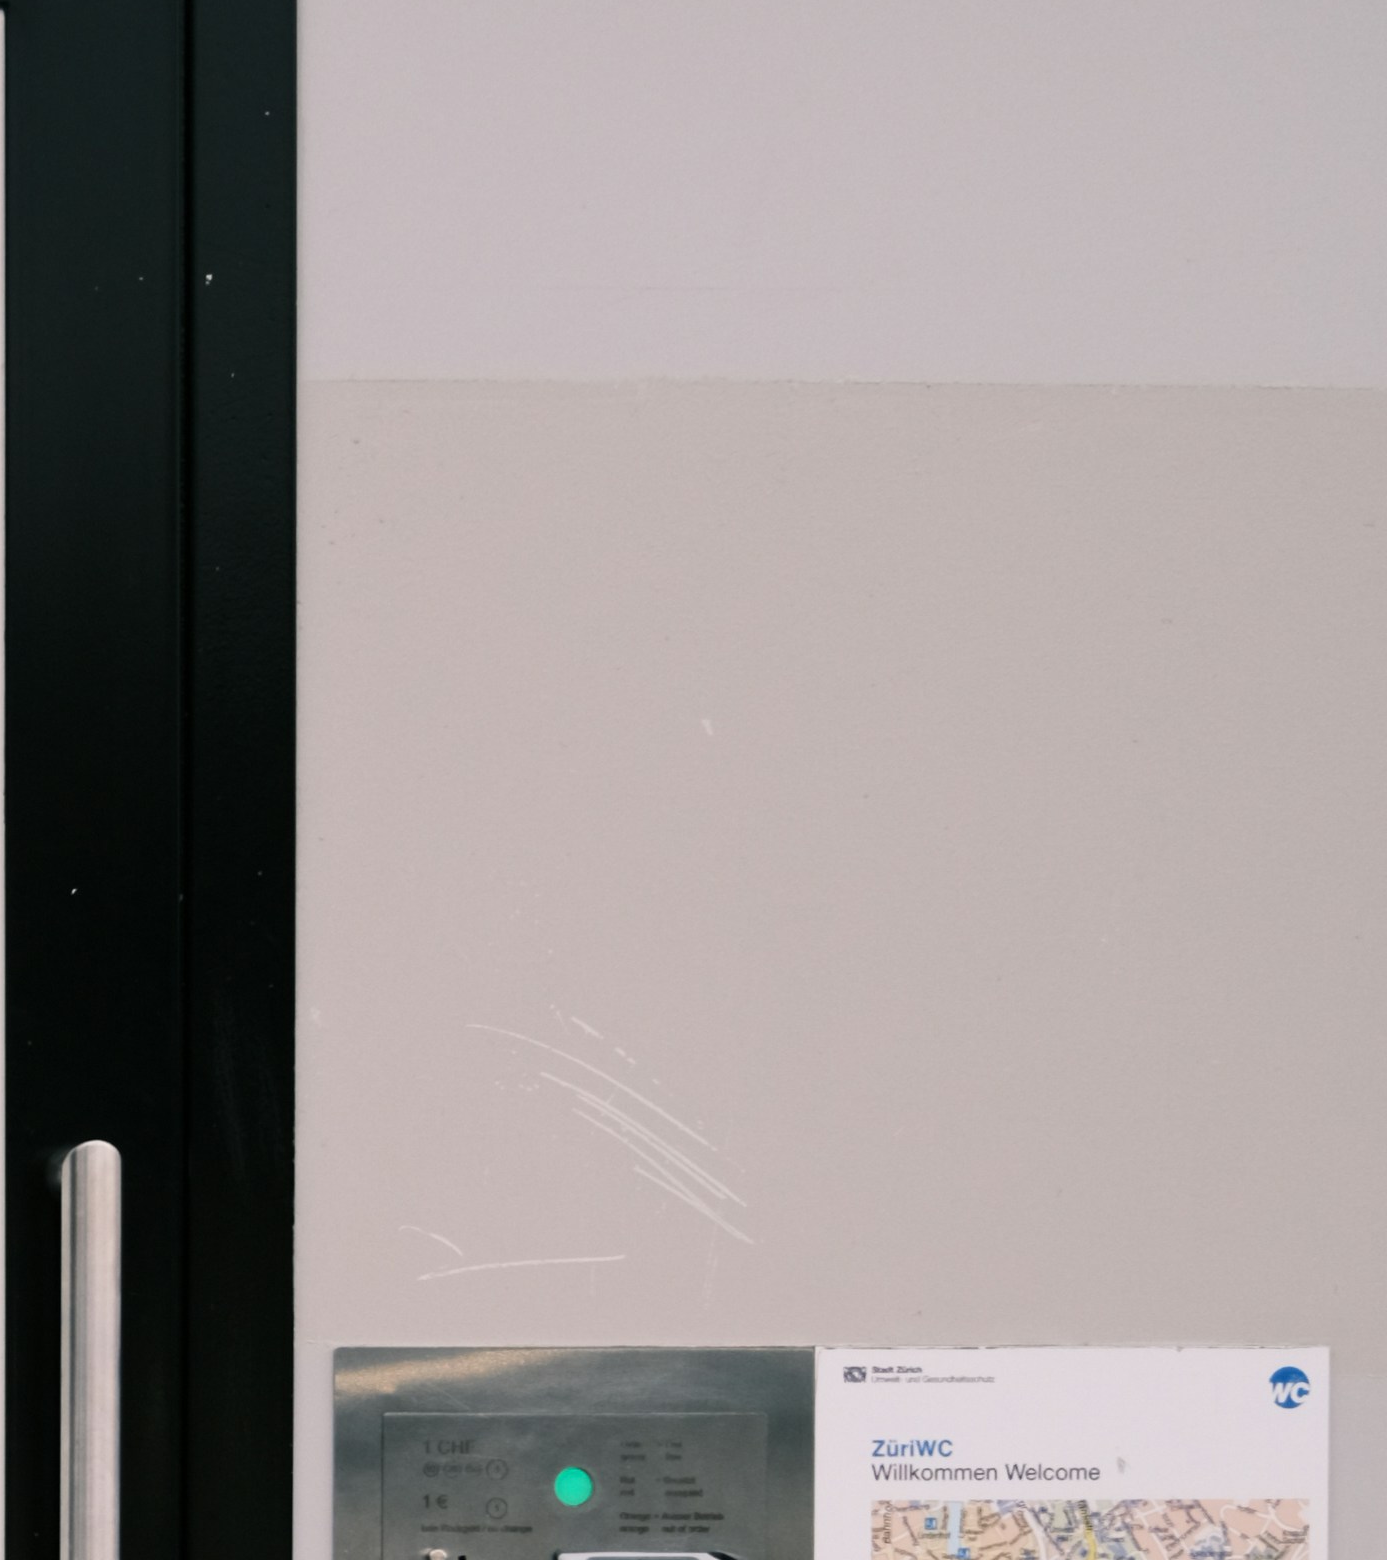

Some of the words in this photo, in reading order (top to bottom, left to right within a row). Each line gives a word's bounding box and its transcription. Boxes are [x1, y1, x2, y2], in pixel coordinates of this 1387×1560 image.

[896, 1365, 923, 1374] Zürich
[1270, 1381, 1310, 1404] WC
[871, 1439, 954, 1457] ZüriWC
[871, 1463, 998, 1481] Willkommen
[1005, 1463, 1101, 1481] Welcome
[422, 1494, 430, 1509] 1
[435, 1494, 449, 1509] €
